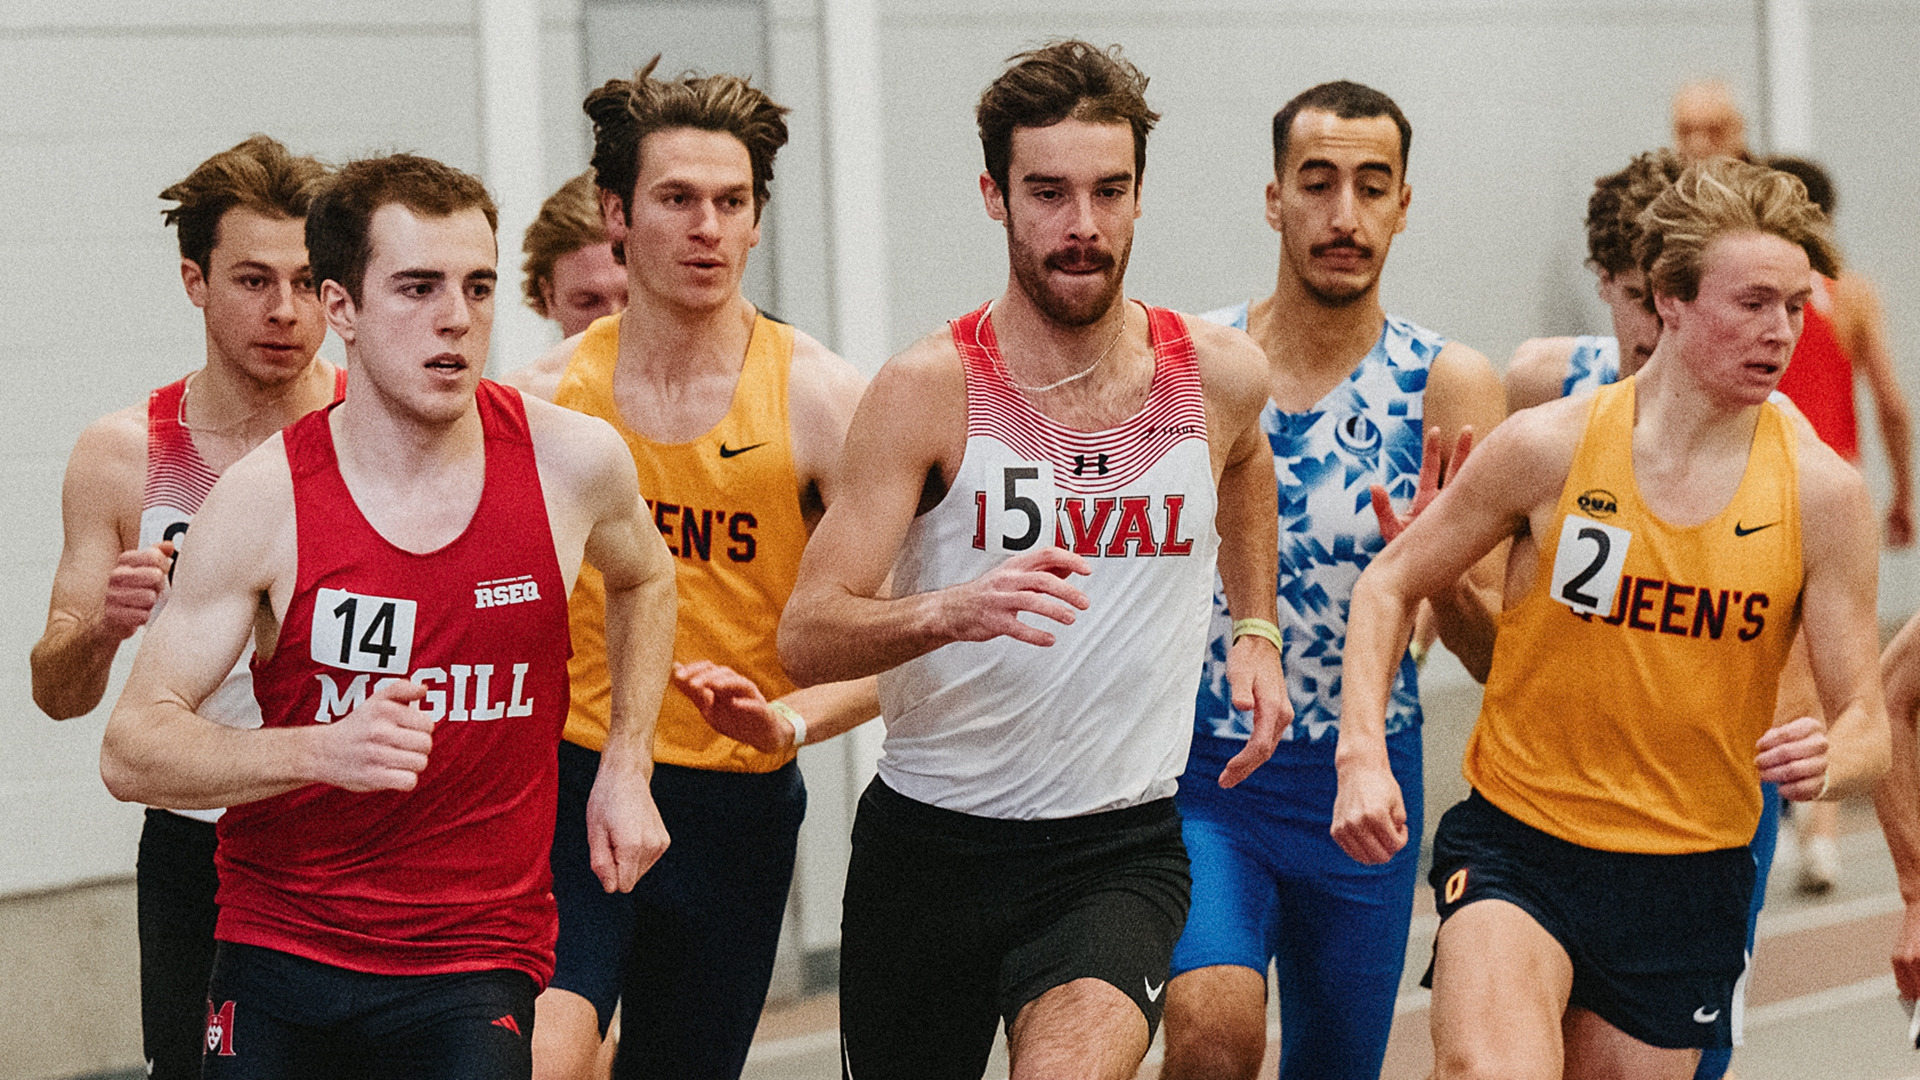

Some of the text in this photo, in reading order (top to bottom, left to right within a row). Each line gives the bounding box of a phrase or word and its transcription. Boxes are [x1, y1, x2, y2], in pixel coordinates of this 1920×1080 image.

[646, 500, 757, 562] EN'S
[972, 491, 1194, 557] VAL
[1002, 467, 1041, 551] 5
[474, 581, 541, 608] RSEQ
[1562, 527, 1611, 608] 2
[333, 597, 397, 668] 14
[1570, 574, 1770, 641] UEEN'S
